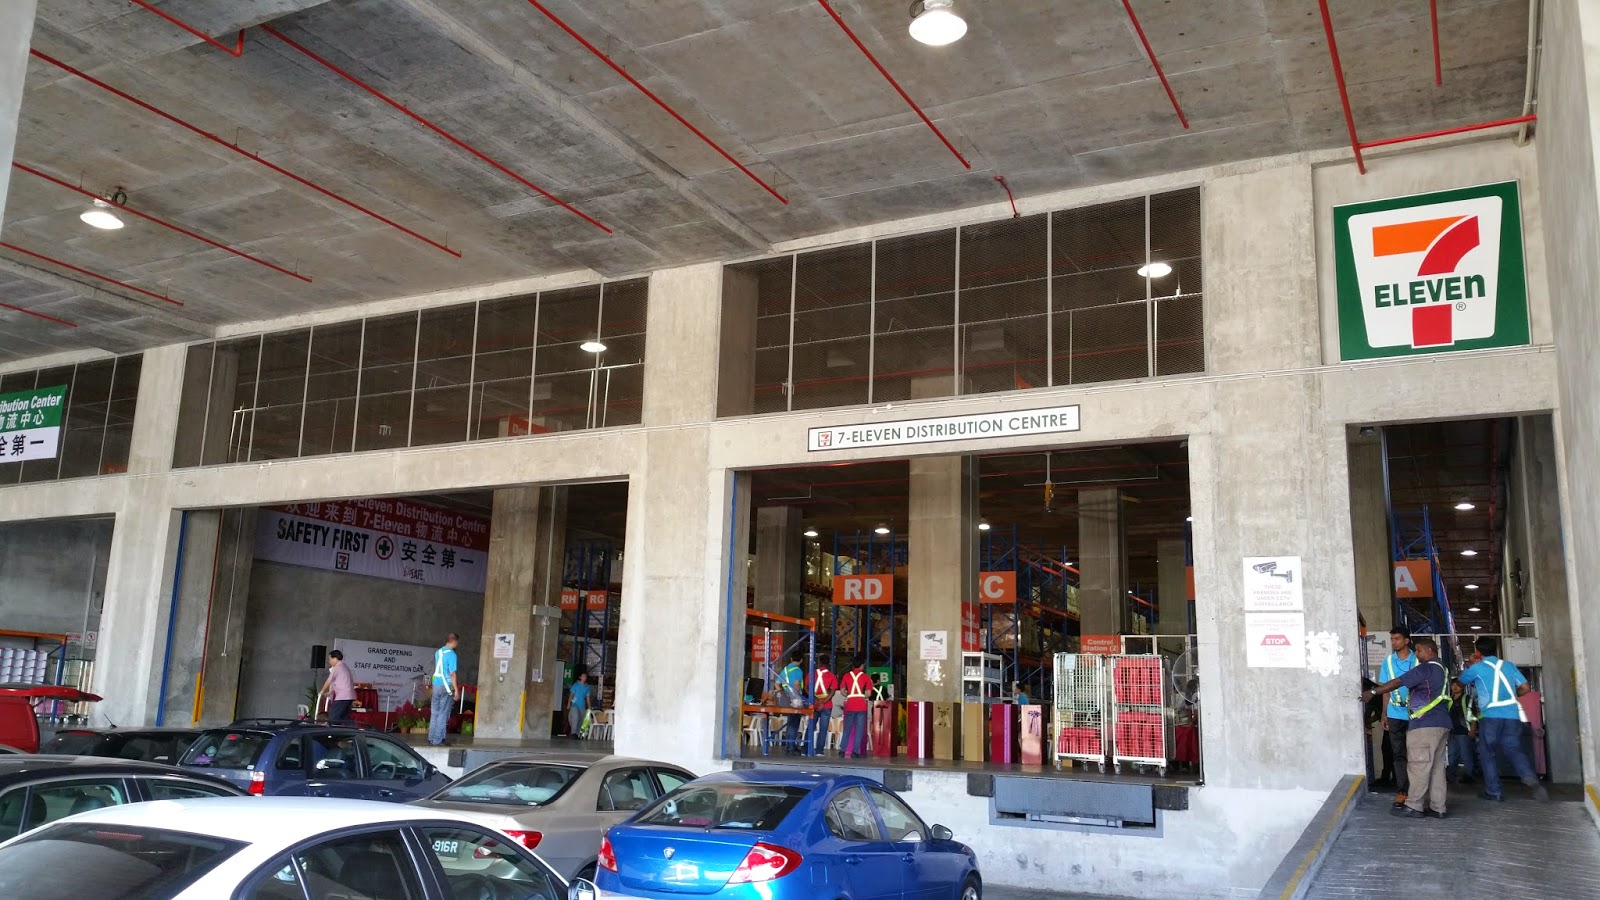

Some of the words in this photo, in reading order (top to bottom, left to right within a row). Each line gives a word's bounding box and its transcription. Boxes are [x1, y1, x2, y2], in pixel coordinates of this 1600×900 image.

[30, 393, 62, 409] Center
[838, 427, 901, 444] 7-ELEVEN
[906, 419, 1003, 439] DISTRIBUTION
[1008, 413, 1068, 431] CENTRE
[396, 501, 453, 526] Distribution
[456, 516, 487, 533] Centre
[277, 518, 330, 547] SAFETY
[332, 528, 370, 553] FIRST
[363, 511, 411, 535] 7-Eleven
[415, 521, 473, 547] 物流中心
[401, 540, 474, 569] 安全第一
[844, 578, 883, 601] RD
[979, 575, 1004, 598] C
[561, 595, 577, 604] RH
[590, 595, 605, 604] RG
[367, 647, 388, 655] GRAND
[388, 649, 413, 657] OPENING
[373, 663, 412, 672] APPRECIATION
[432, 840, 458, 853] 916R
